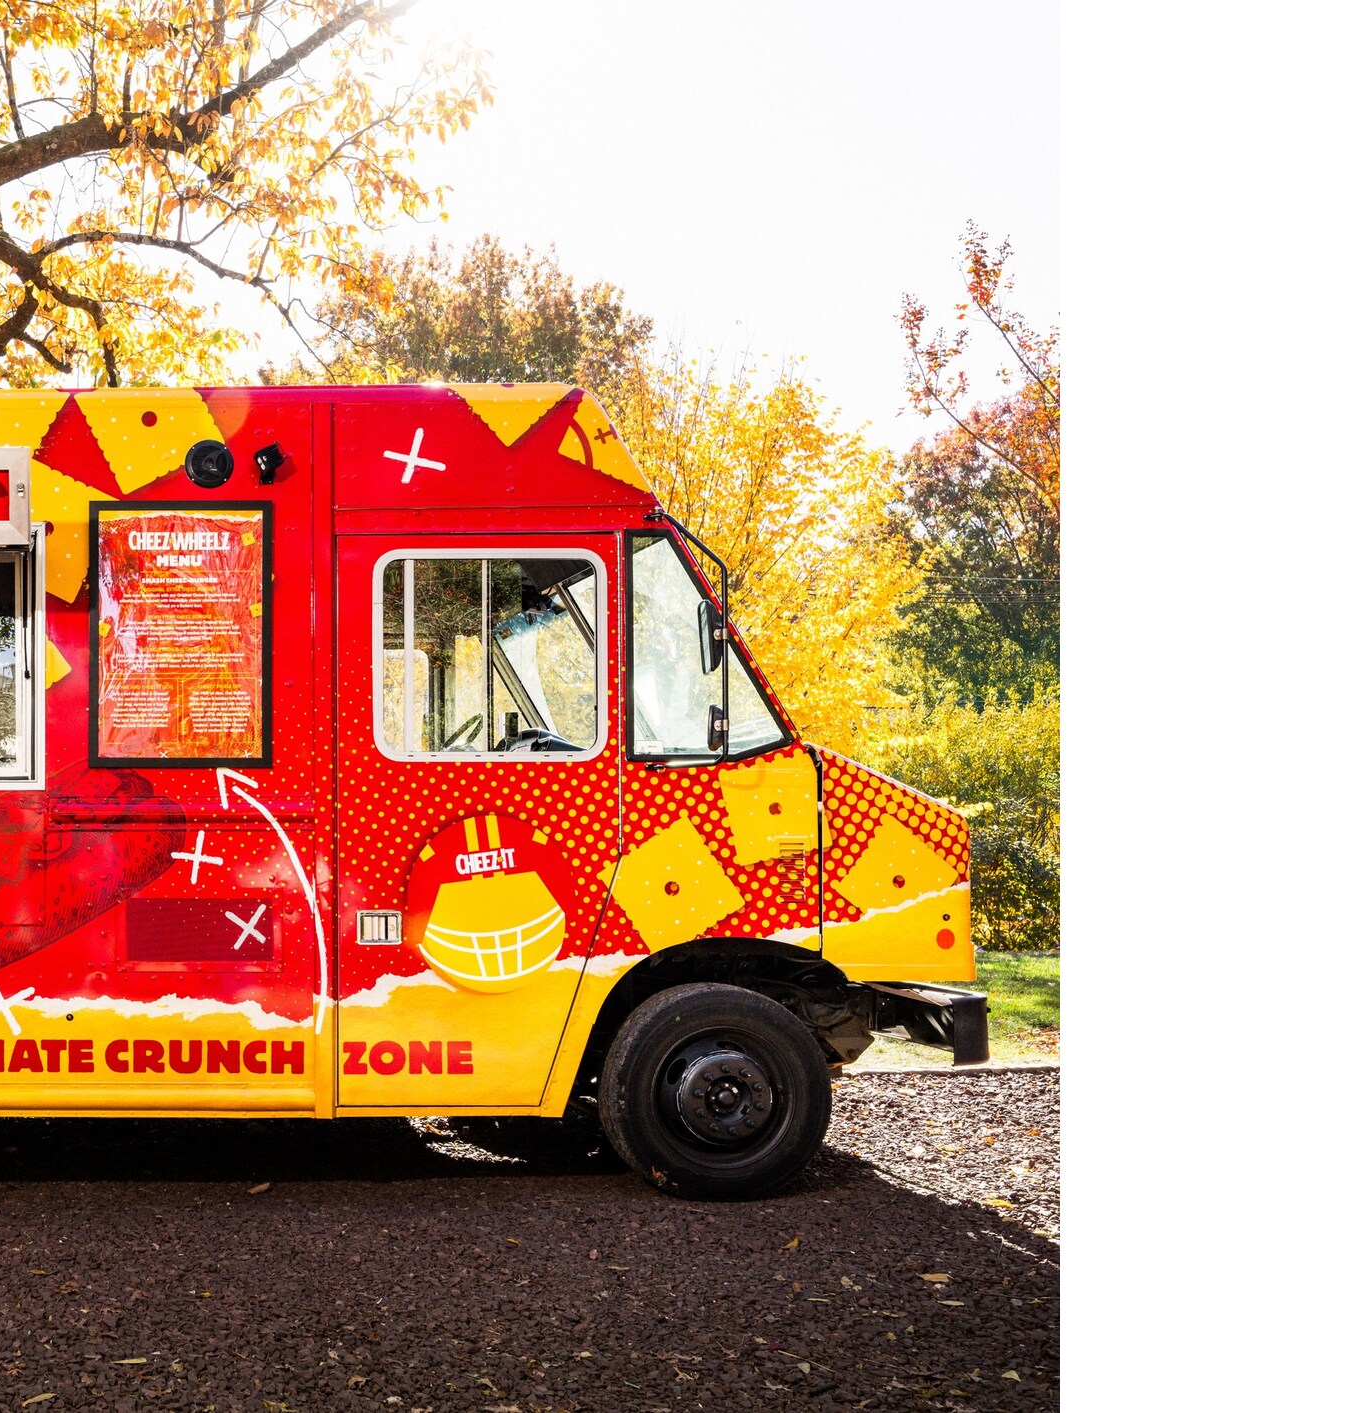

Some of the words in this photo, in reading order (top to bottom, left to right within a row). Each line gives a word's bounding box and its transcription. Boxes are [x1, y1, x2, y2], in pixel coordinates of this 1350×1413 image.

[156, 554, 202, 567] MENU
[455, 848, 516, 875] CHEEZ-IT
[104, 1040, 306, 1074] CRUNCH
[342, 1041, 474, 1075] ZONE
